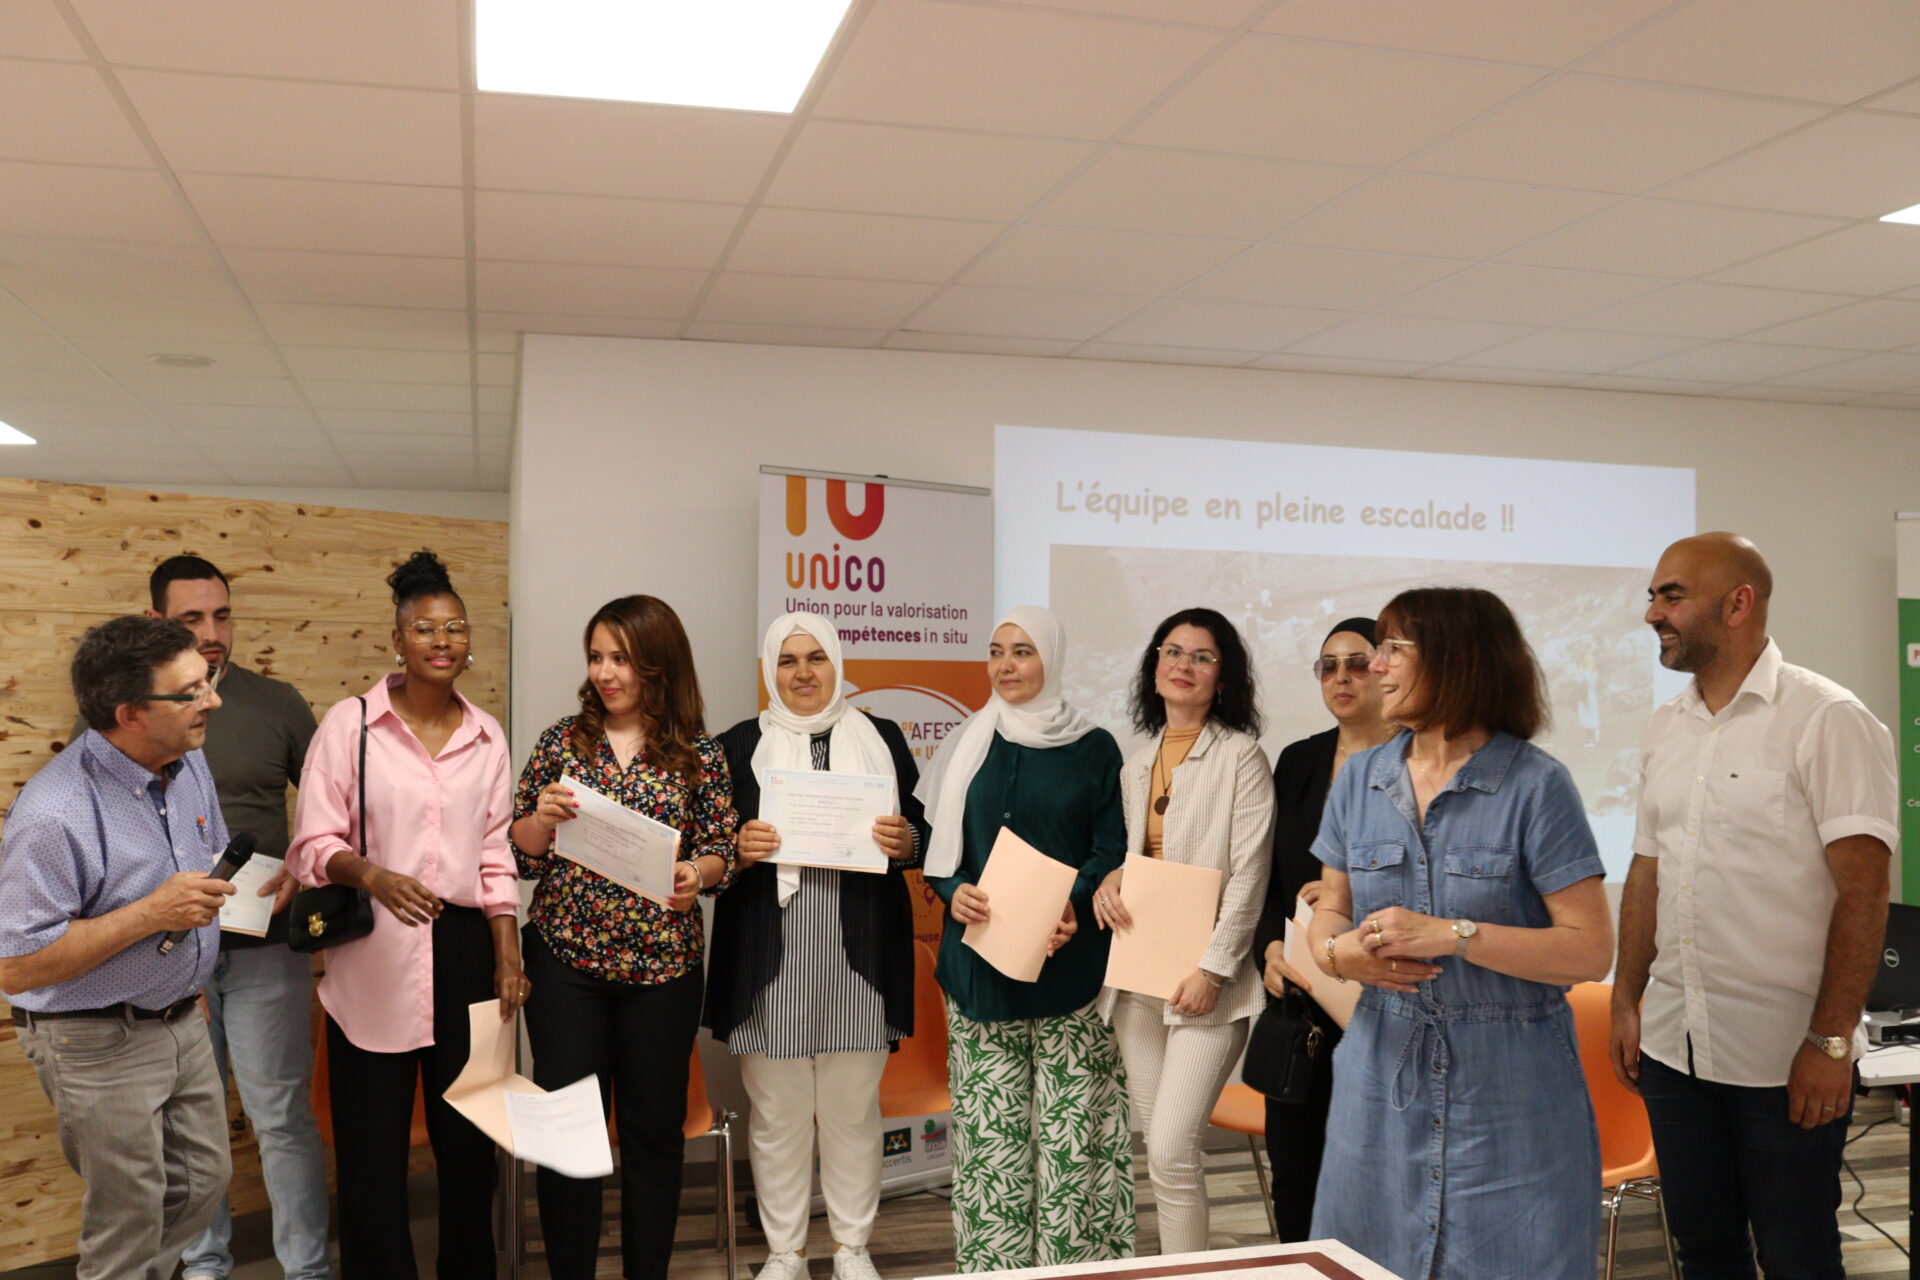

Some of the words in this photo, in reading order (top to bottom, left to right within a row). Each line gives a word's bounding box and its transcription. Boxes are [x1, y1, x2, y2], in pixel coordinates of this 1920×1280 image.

[1056, 481, 1189, 525] L'équipe
[1204, 497, 1241, 520] en
[1256, 491, 1345, 530] pleine
[1360, 499, 1488, 532] escalade
[1500, 504, 1515, 533] !!
[785, 597, 829, 615] Union
[834, 603, 867, 620] pour
[870, 601, 883, 617] la
[887, 602, 968, 620] valorisation
[838, 626, 921, 645] mpétences
[924, 628, 938, 644] in
[943, 628, 968, 645] situ
